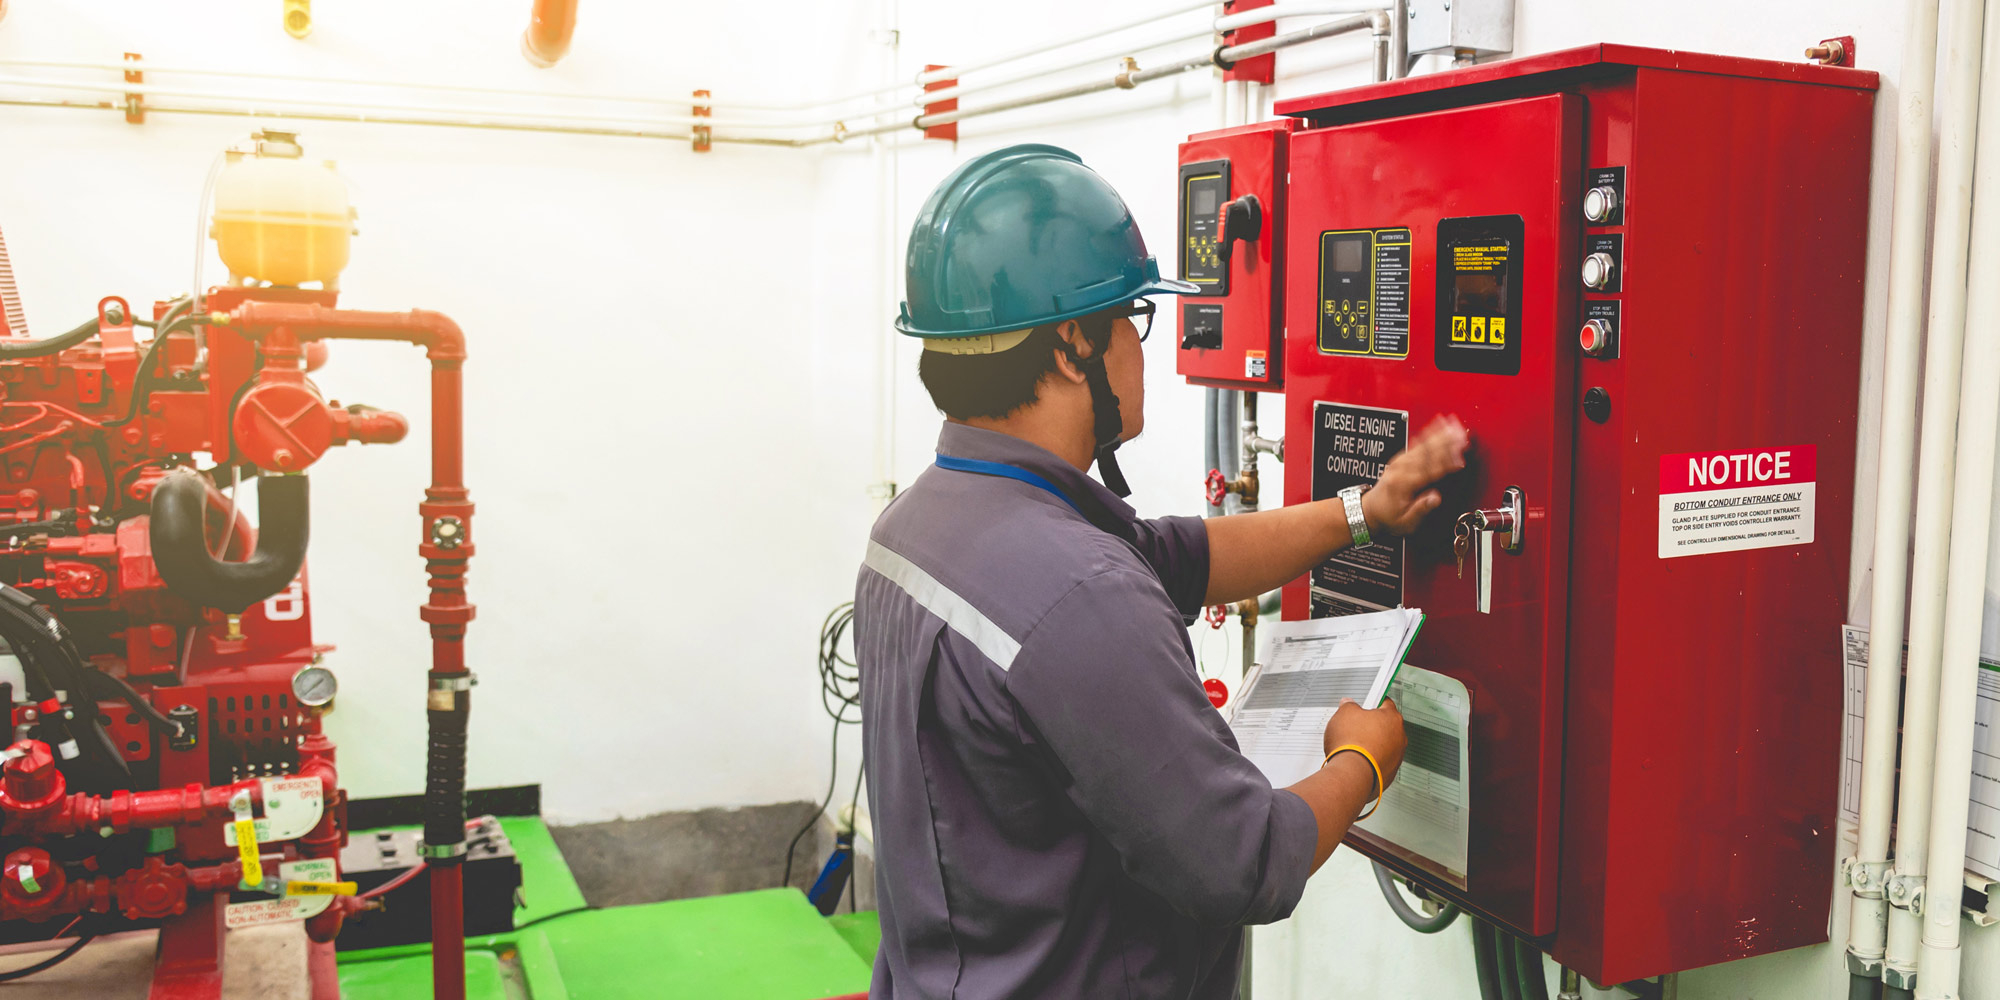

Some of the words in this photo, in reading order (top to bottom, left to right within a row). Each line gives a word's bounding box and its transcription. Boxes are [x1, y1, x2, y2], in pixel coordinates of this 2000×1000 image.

[1324, 411, 1356, 433] DIESEL
[1359, 416, 1396, 438] ENGINE
[1334, 434, 1355, 454] FIRE
[1356, 438, 1385, 458] PUMP
[1688, 451, 1791, 486] NOTICE
[1674, 499, 1706, 511] BOTTOM
[1708, 497, 1740, 508] CONDUIT
[1742, 494, 1781, 505] ENTRANCE
[1783, 491, 1802, 501] ONLY
[1710, 513, 1736, 521] SUPPLIED
[1749, 509, 1772, 517] CONDUIT
[1739, 517, 1772, 526] CONTROLLER
[1687, 537, 1717, 545] CONTROLLER
[1717, 534, 1747, 542] DIMENSIONAL
[272, 780, 318, 793] EMERGENCY
[300, 790, 322, 800] OPEN
[309, 872, 332, 881] OPEN
[228, 904, 263, 916] CAUTION
[229, 910, 292, 925] NON-AUTOMATIC
